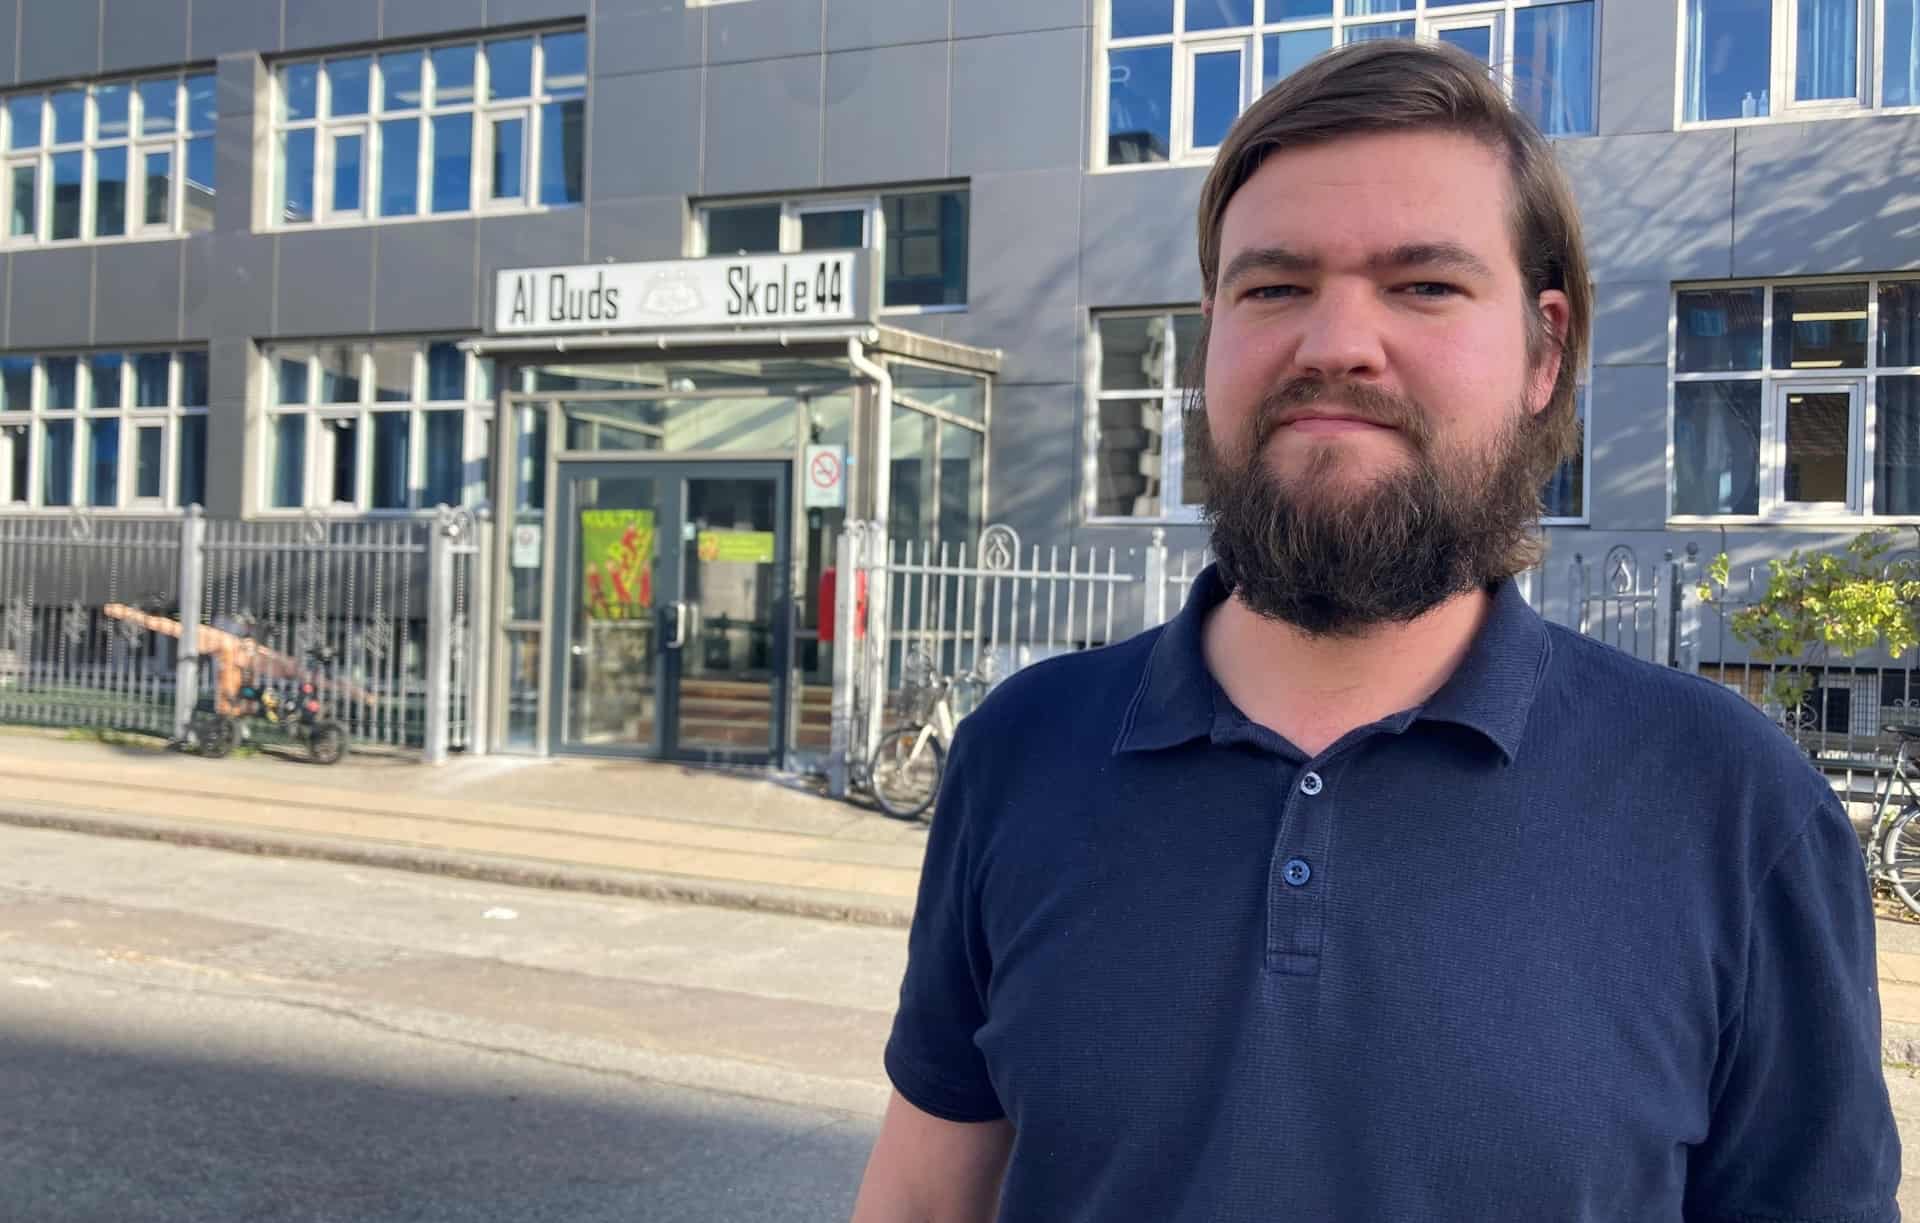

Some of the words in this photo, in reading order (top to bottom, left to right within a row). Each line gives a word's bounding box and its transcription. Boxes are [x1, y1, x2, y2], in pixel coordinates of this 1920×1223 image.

[511, 274, 536, 325] Al
[549, 271, 620, 321] Quds
[726, 264, 808, 316] Skole
[814, 260, 842, 313] 44
